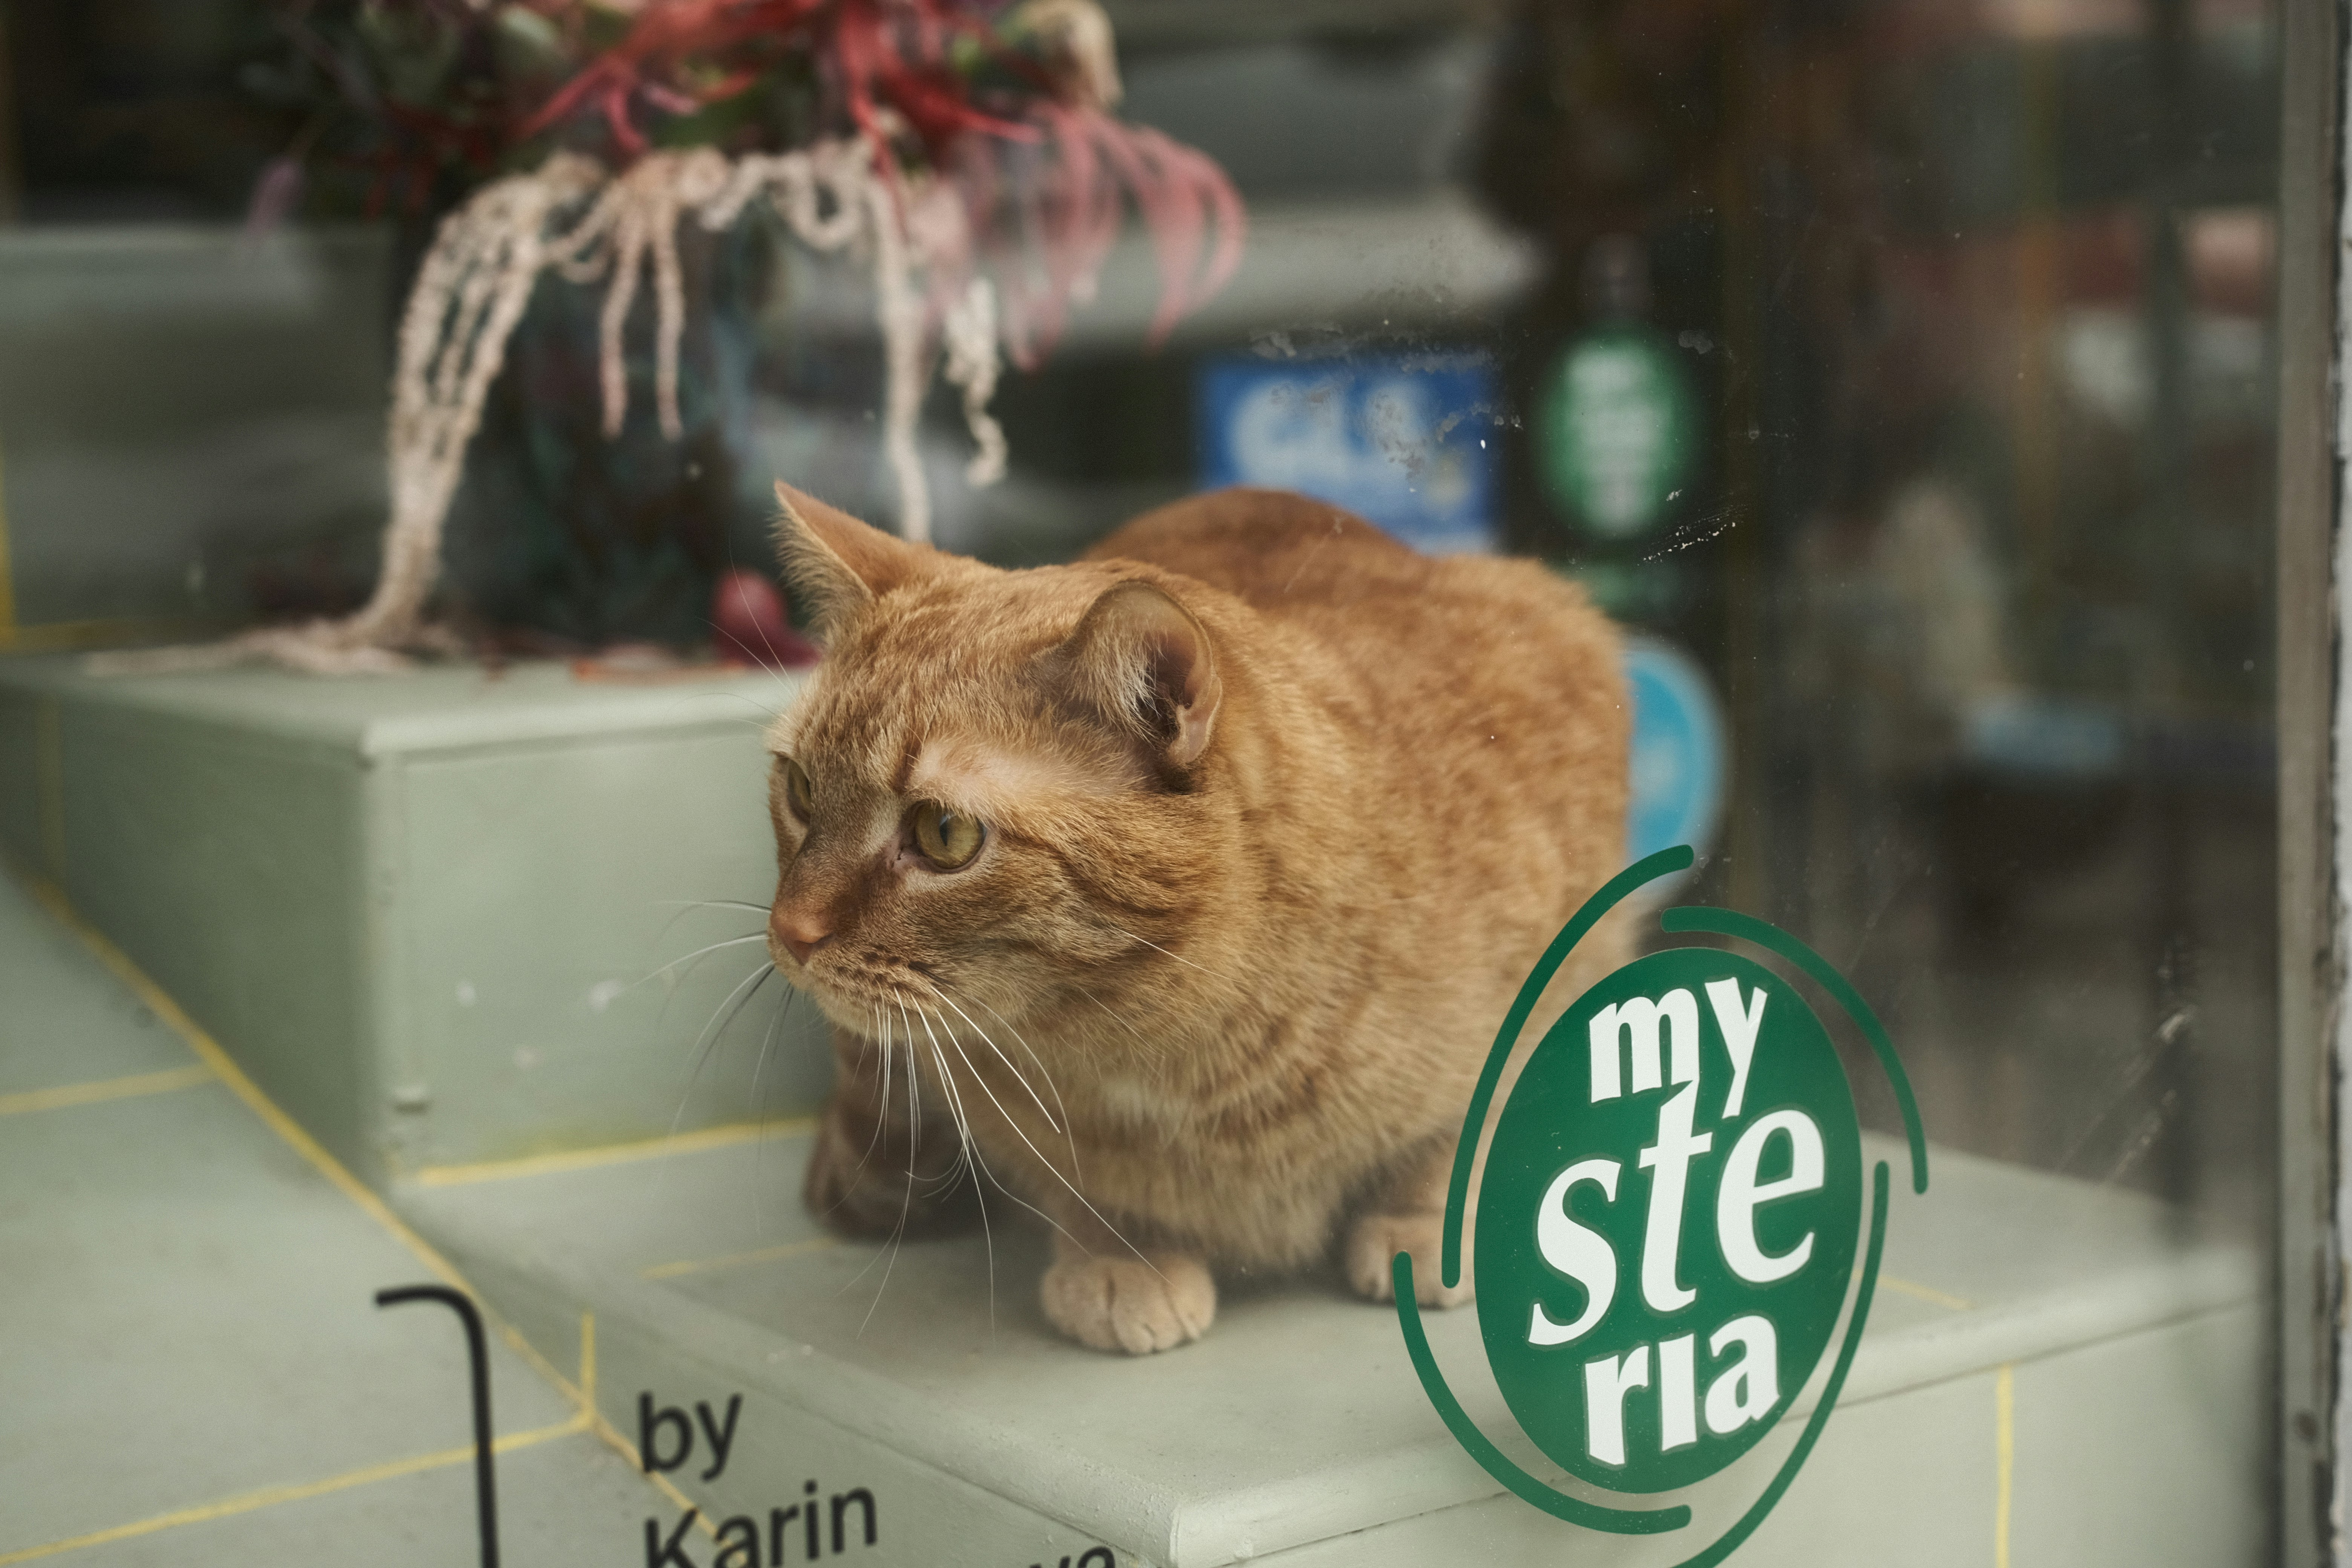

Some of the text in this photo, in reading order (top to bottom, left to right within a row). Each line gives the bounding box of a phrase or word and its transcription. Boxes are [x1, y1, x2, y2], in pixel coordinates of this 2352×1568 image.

[1589, 977, 1768, 1119] my
[1528, 1080, 1824, 1346] ste
[637, 1391, 743, 1483] by
[644, 1479, 877, 1568] Karin
